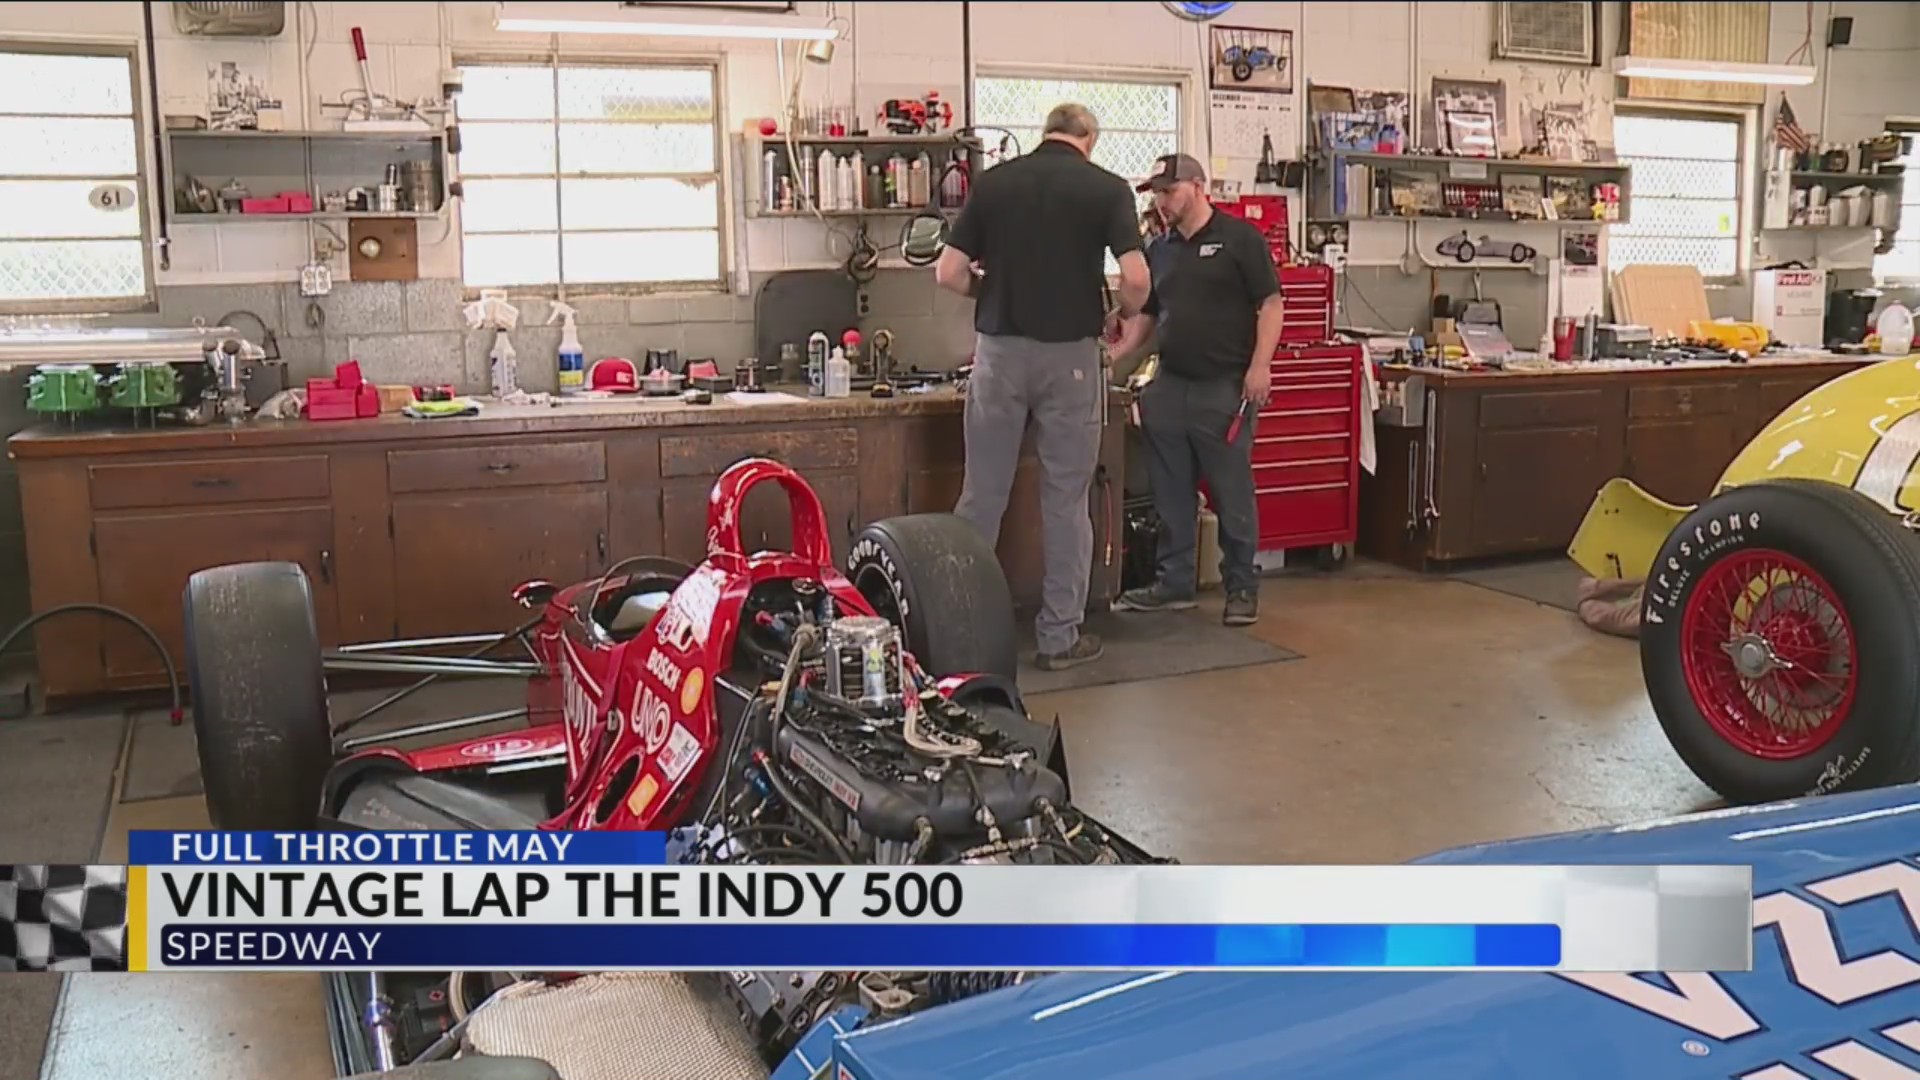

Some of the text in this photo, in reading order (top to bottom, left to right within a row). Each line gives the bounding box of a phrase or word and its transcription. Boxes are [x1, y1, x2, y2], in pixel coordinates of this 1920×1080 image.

[101, 191, 121, 206] 61
[848, 539, 909, 616] GOODYEAR
[1646, 512, 1760, 623] Firestone
[646, 646, 682, 692] BOSCH
[631, 680, 670, 755] UNO
